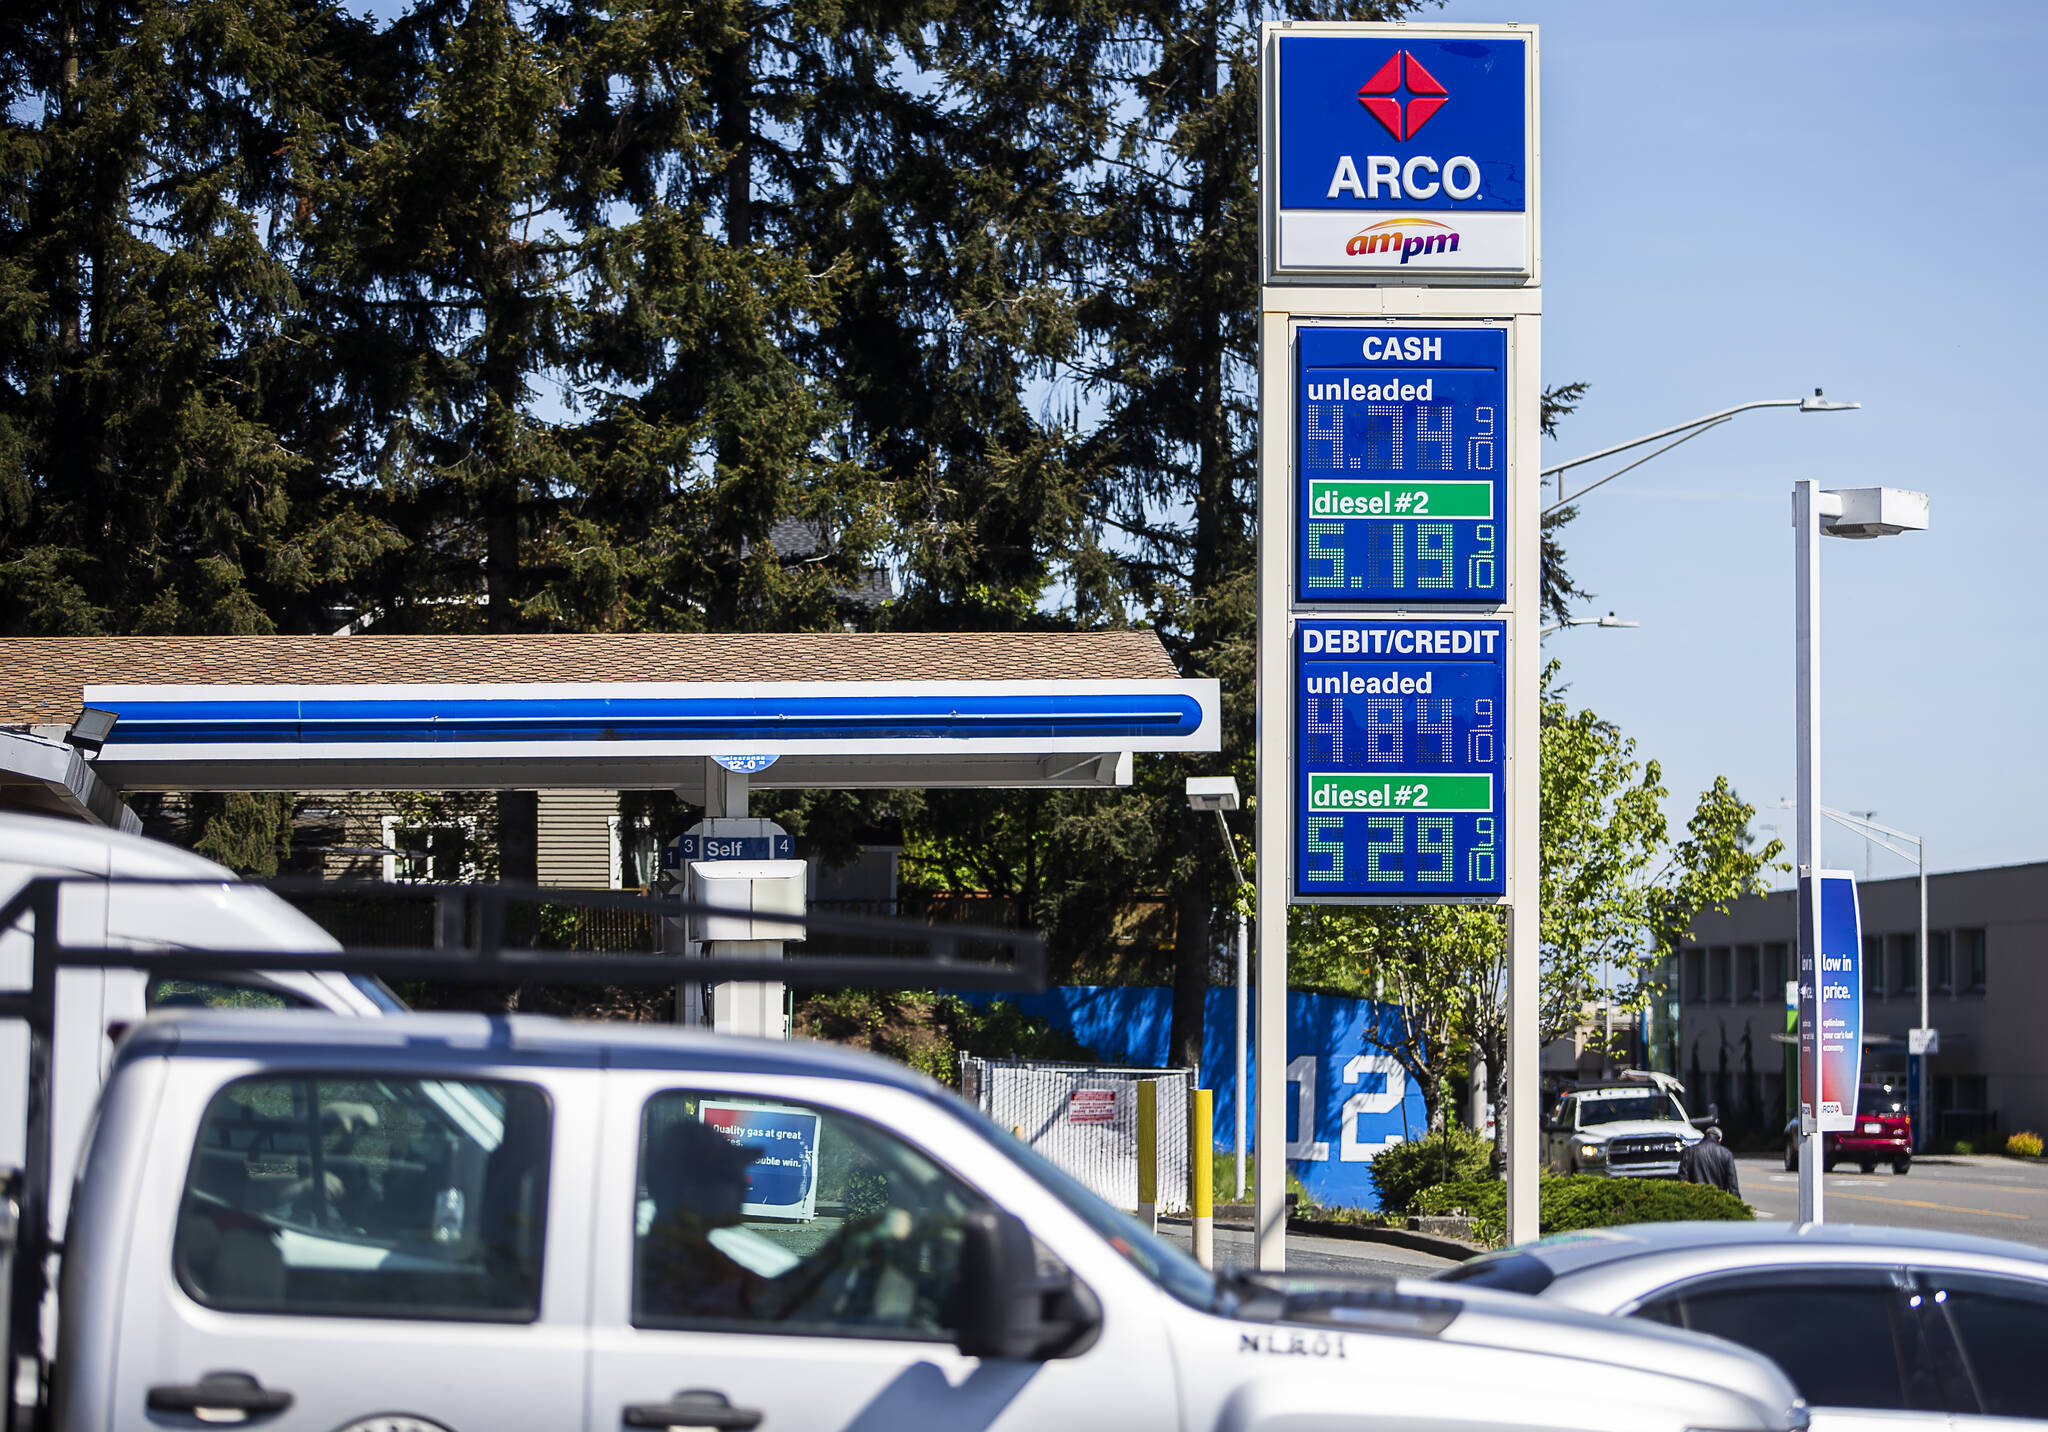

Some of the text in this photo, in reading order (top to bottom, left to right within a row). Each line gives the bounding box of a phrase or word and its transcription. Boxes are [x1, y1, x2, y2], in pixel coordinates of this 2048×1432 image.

[1326, 155, 1481, 200] ARCO
[1345, 232, 1460, 264] ampm
[1362, 336, 1442, 361] CASH
[1307, 377, 1433, 401] unleaded
[1314, 490, 1429, 514] diesel #2
[1303, 630, 1500, 654] DEBIT/CREDIT
[1306, 671, 1432, 694] unleaded
[1313, 784, 1429, 807] diesel #2
[684, 839, 694, 853] 3
[707, 841, 743, 857] Self
[779, 839, 789, 853] 4
[1822, 953, 1852, 972] low in
[1823, 982, 1851, 1003] price.
[713, 1123, 801, 1140] Quality gas at great
[752, 1156, 802, 1168] ouble win.
